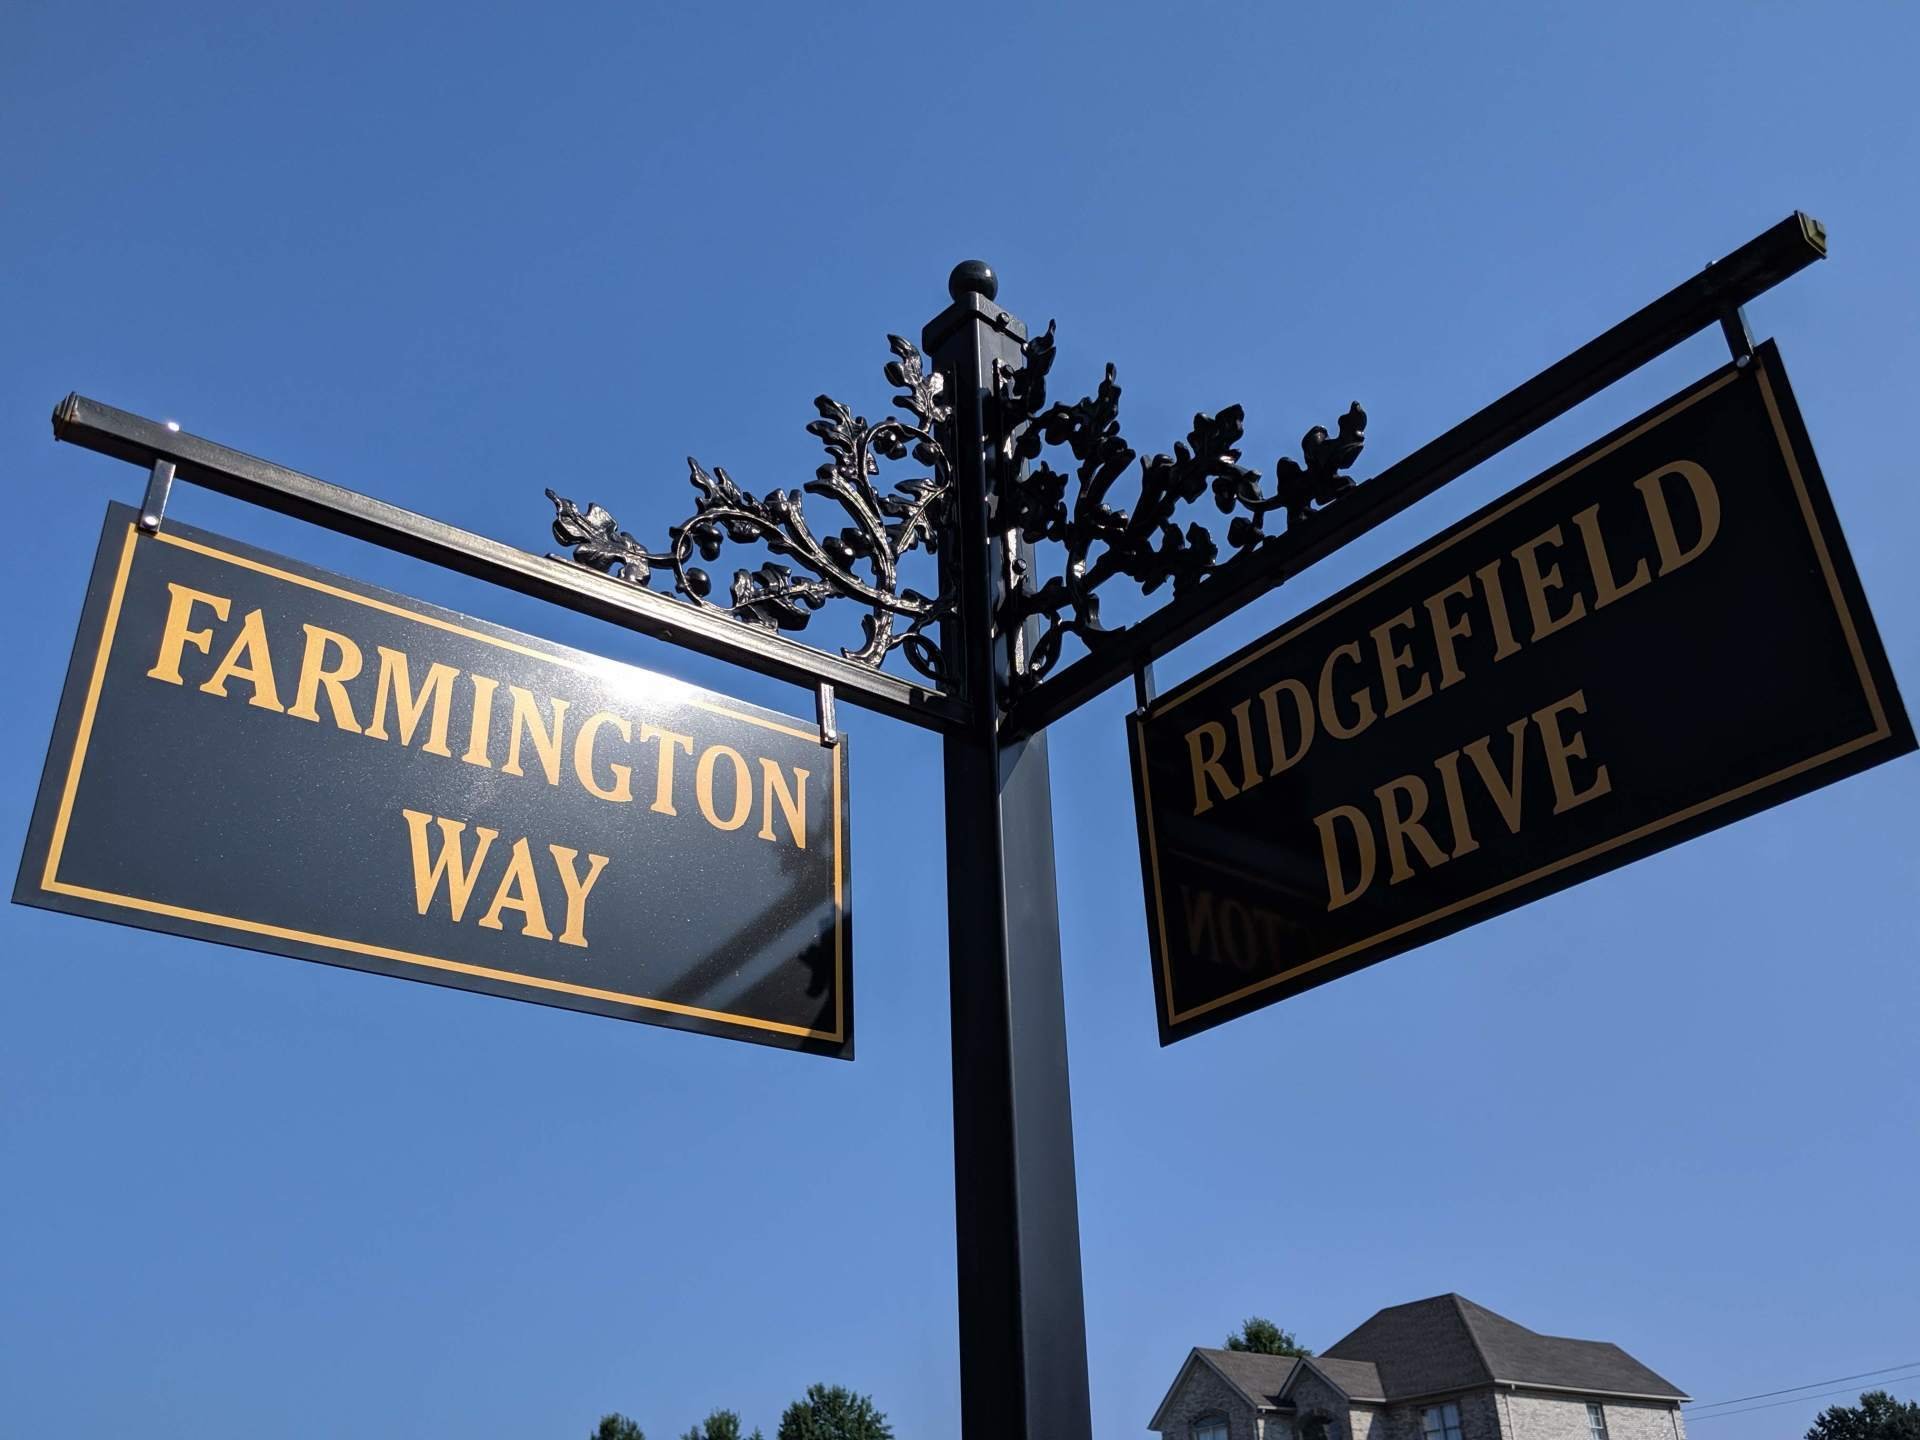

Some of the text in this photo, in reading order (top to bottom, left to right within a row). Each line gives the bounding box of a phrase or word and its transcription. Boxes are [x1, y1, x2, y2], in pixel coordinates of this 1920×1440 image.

[147, 582, 810, 849] FARMINGTON
[1185, 460, 1721, 816] RIDGEFIELD
[402, 809, 610, 948] WAY
[1313, 690, 1612, 912] DRIVE
